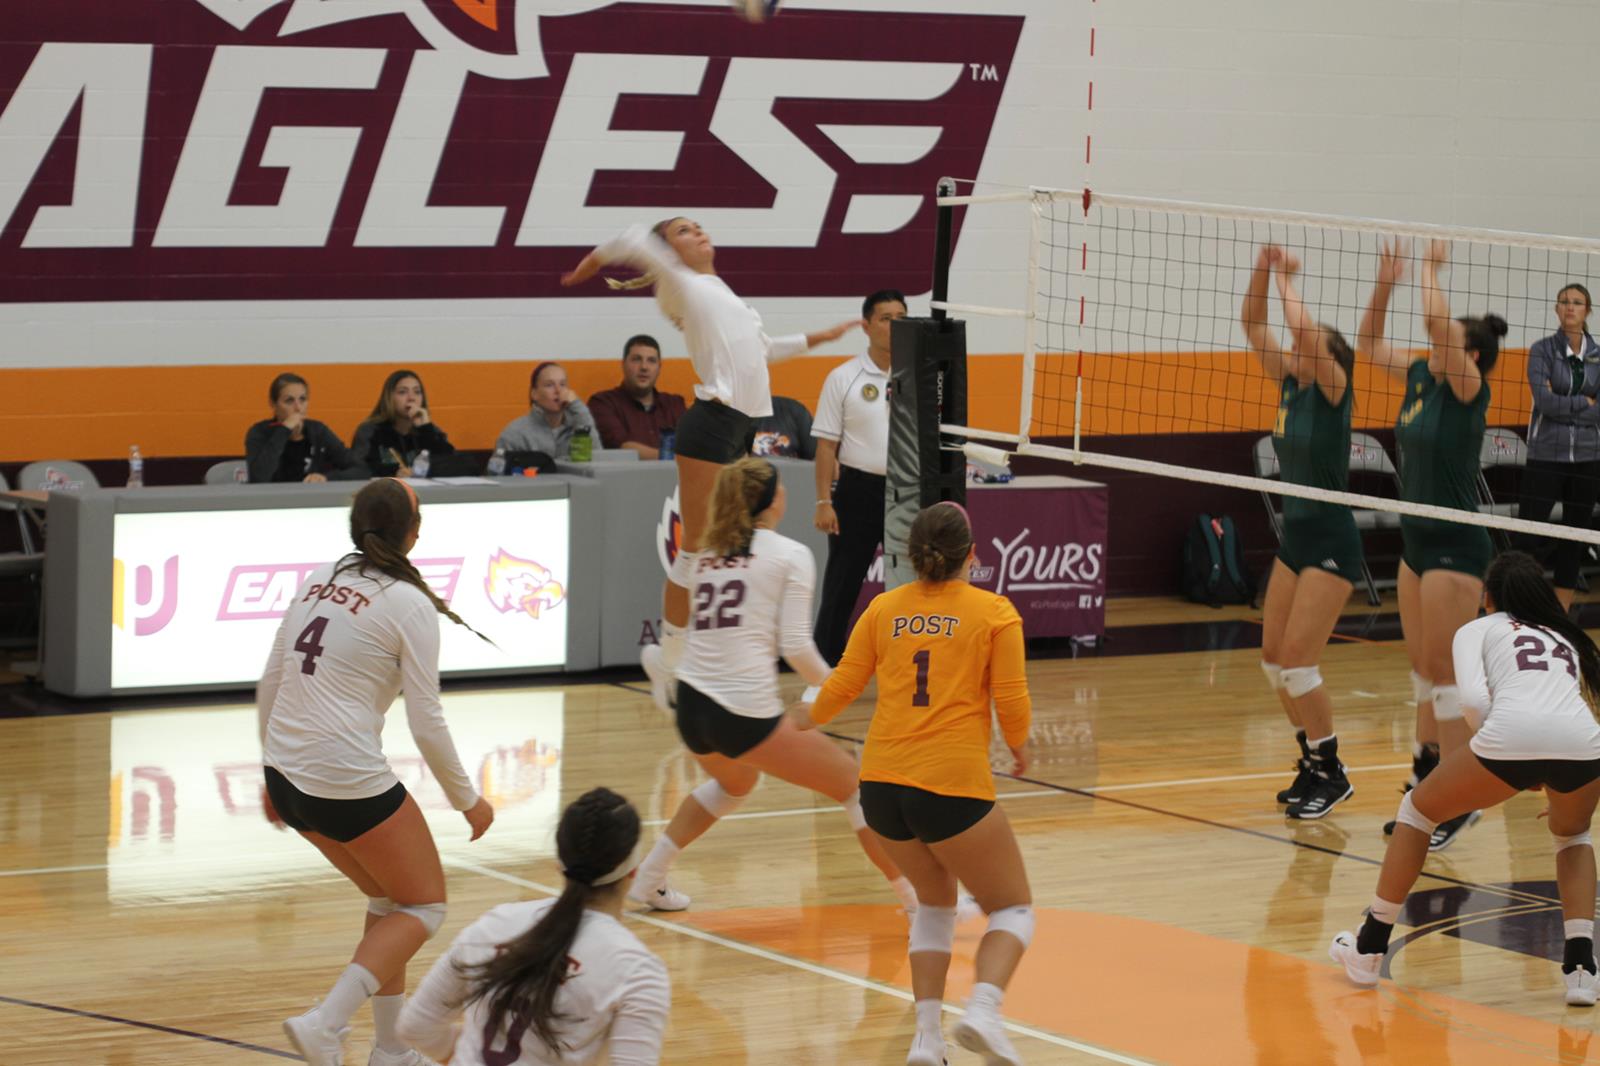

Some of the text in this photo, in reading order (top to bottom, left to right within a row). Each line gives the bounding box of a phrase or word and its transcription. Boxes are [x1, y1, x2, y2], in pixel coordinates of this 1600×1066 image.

[969, 63, 999, 81] TM
[302, 583, 370, 615] POST
[694, 579, 746, 630] 22
[293, 616, 330, 676] 4
[891, 614, 960, 638] POST
[912, 649, 930, 707] 1
[1512, 635, 1578, 680] 24
